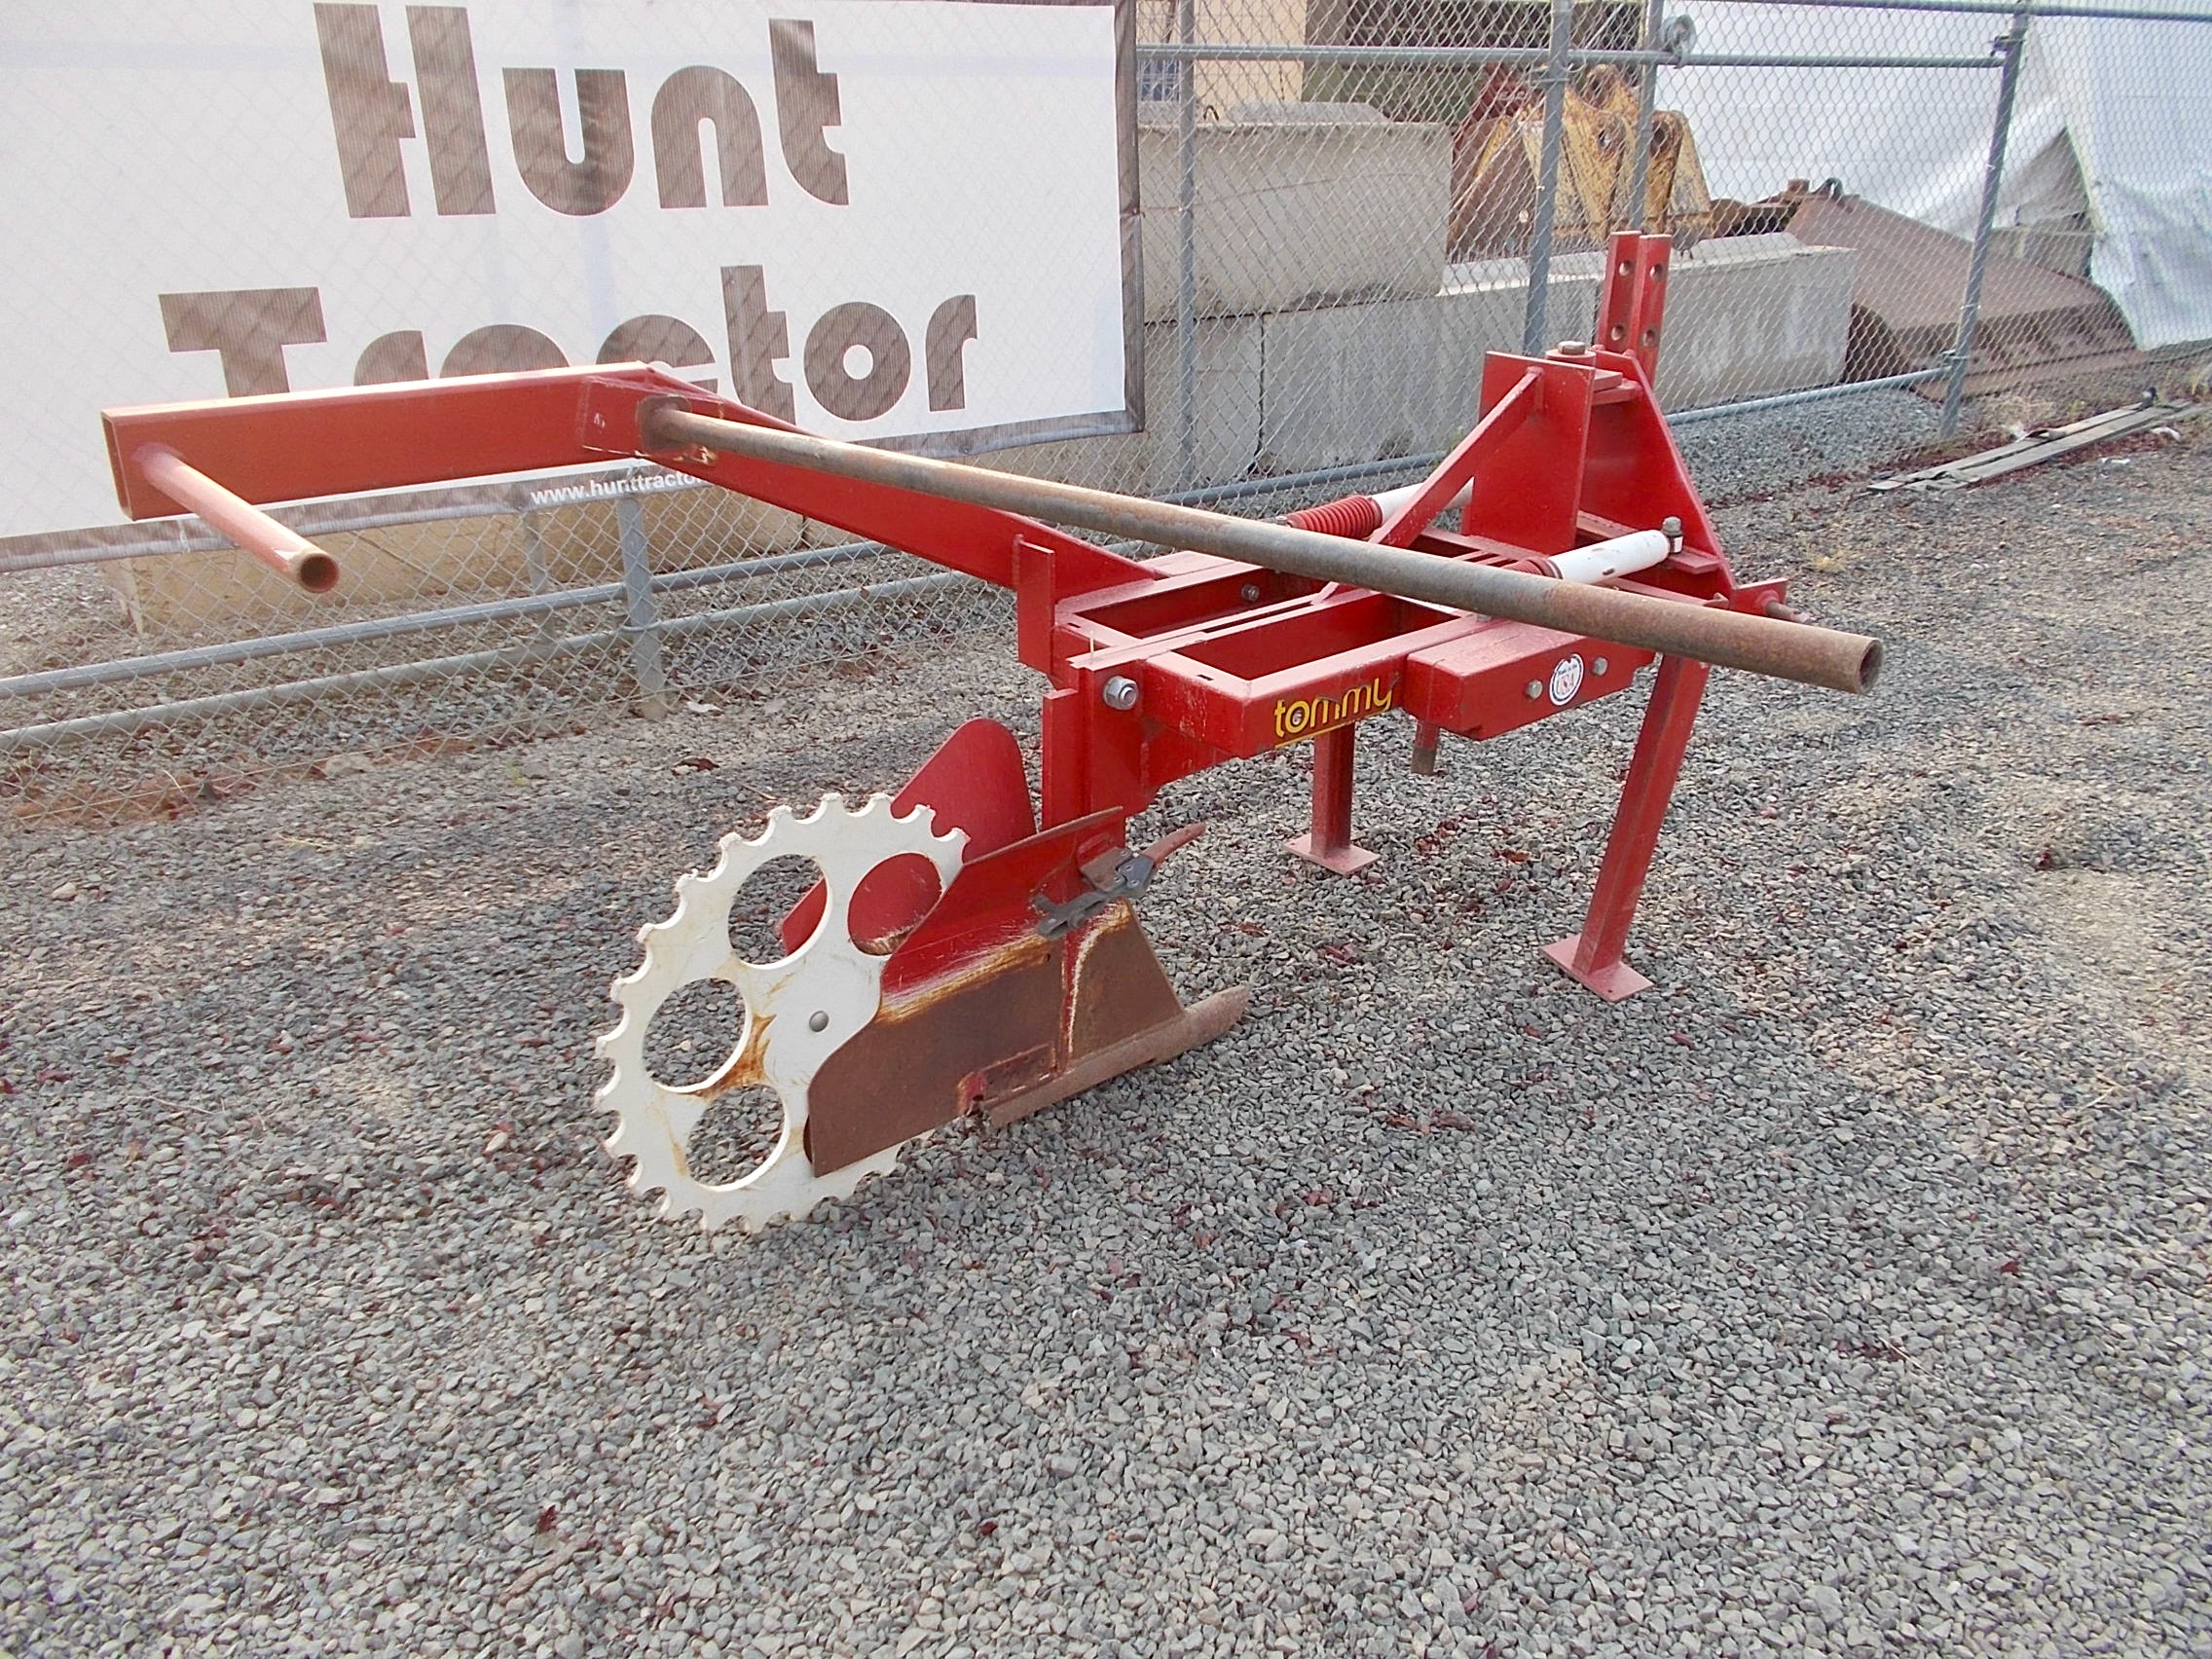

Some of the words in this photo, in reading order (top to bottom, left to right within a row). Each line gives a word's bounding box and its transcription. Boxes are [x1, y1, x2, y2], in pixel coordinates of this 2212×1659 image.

[313, 2, 849, 218] Hunt
[531, 471, 702, 505] www.hunttracto
[1273, 678, 1393, 738] tommy
